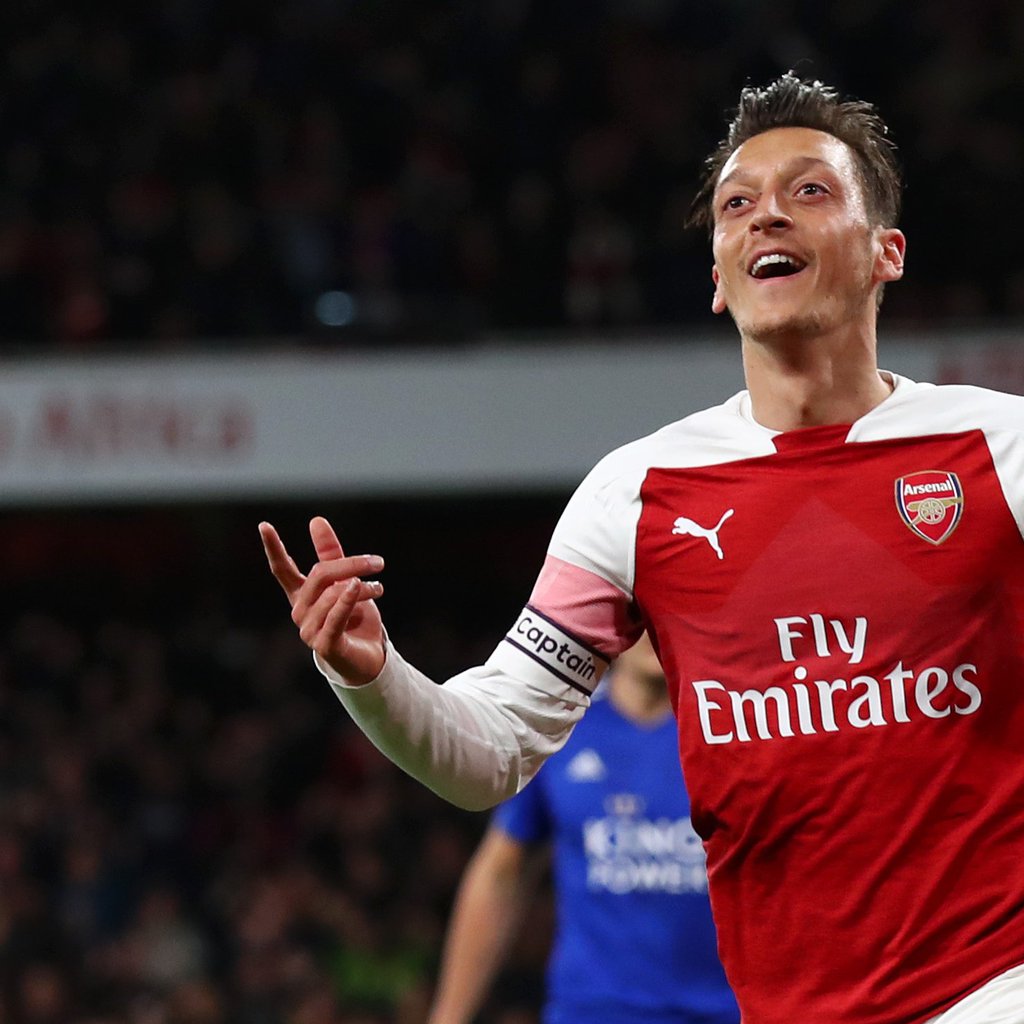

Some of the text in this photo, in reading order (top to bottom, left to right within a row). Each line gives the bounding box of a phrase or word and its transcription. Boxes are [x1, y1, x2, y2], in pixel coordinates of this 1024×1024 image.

[904, 480, 952, 496] Arsenal
[773, 613, 868, 664] Fly
[692, 660, 982, 744] Emirates
